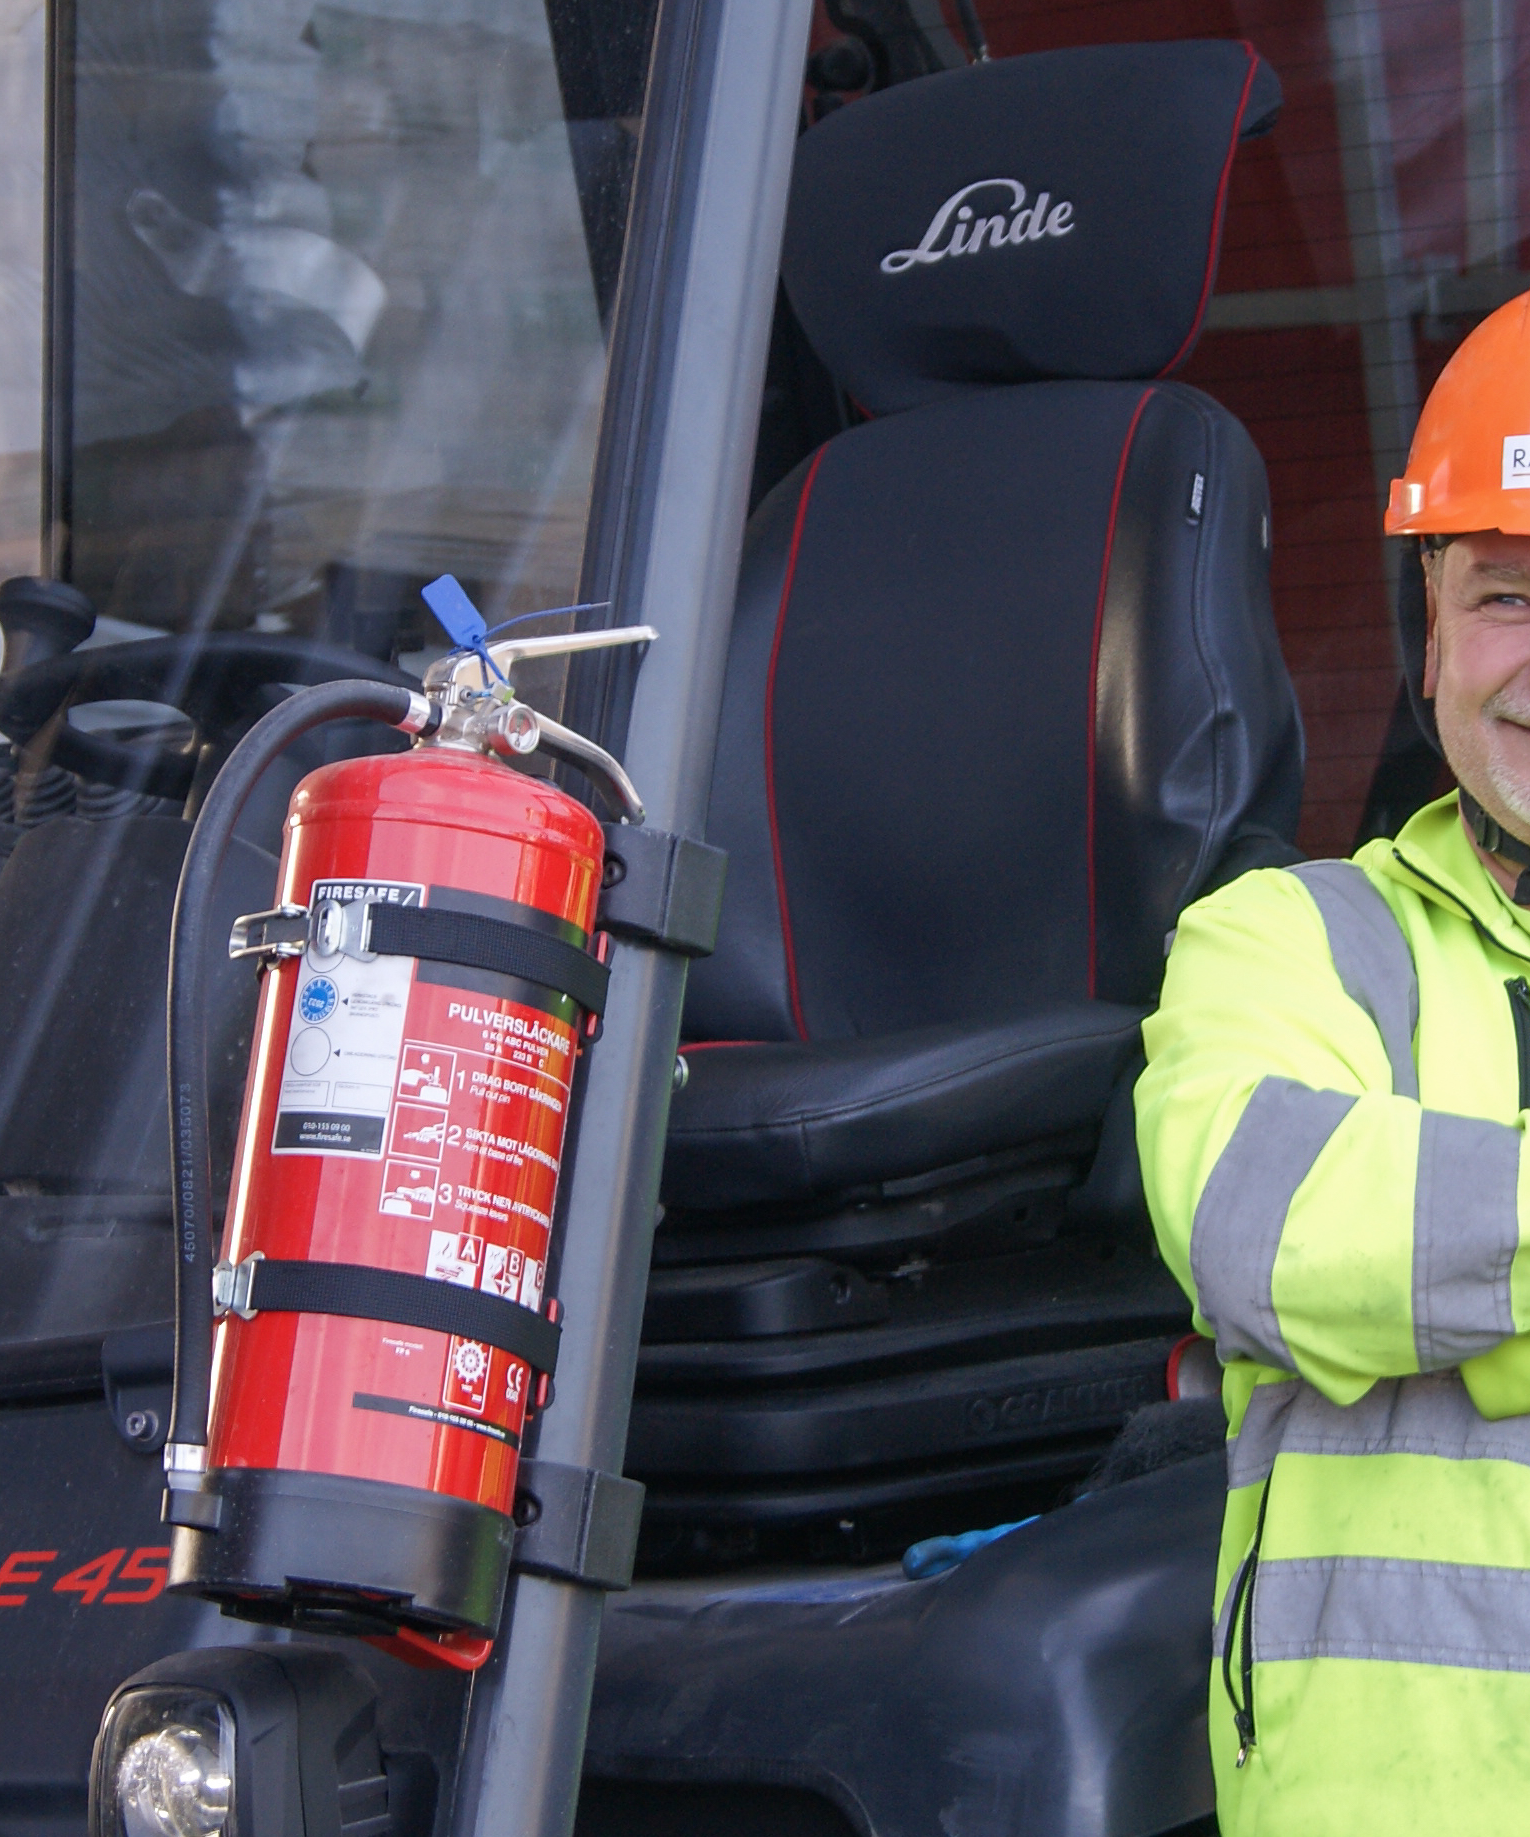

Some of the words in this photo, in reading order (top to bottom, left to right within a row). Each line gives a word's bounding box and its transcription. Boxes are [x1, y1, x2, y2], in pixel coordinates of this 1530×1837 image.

[880, 178, 1075, 274] Linde
[317, 885, 400, 901] FIRESAFE
[456, 1070, 466, 1090] 1
[471, 1071, 502, 1088] DRAG
[503, 1079, 529, 1097] BORT
[446, 1125, 462, 1146] 2
[438, 1183, 453, 1204] 3
[457, 1185, 491, 1204] TRYCK
[52, 1547, 171, 1605] 45
